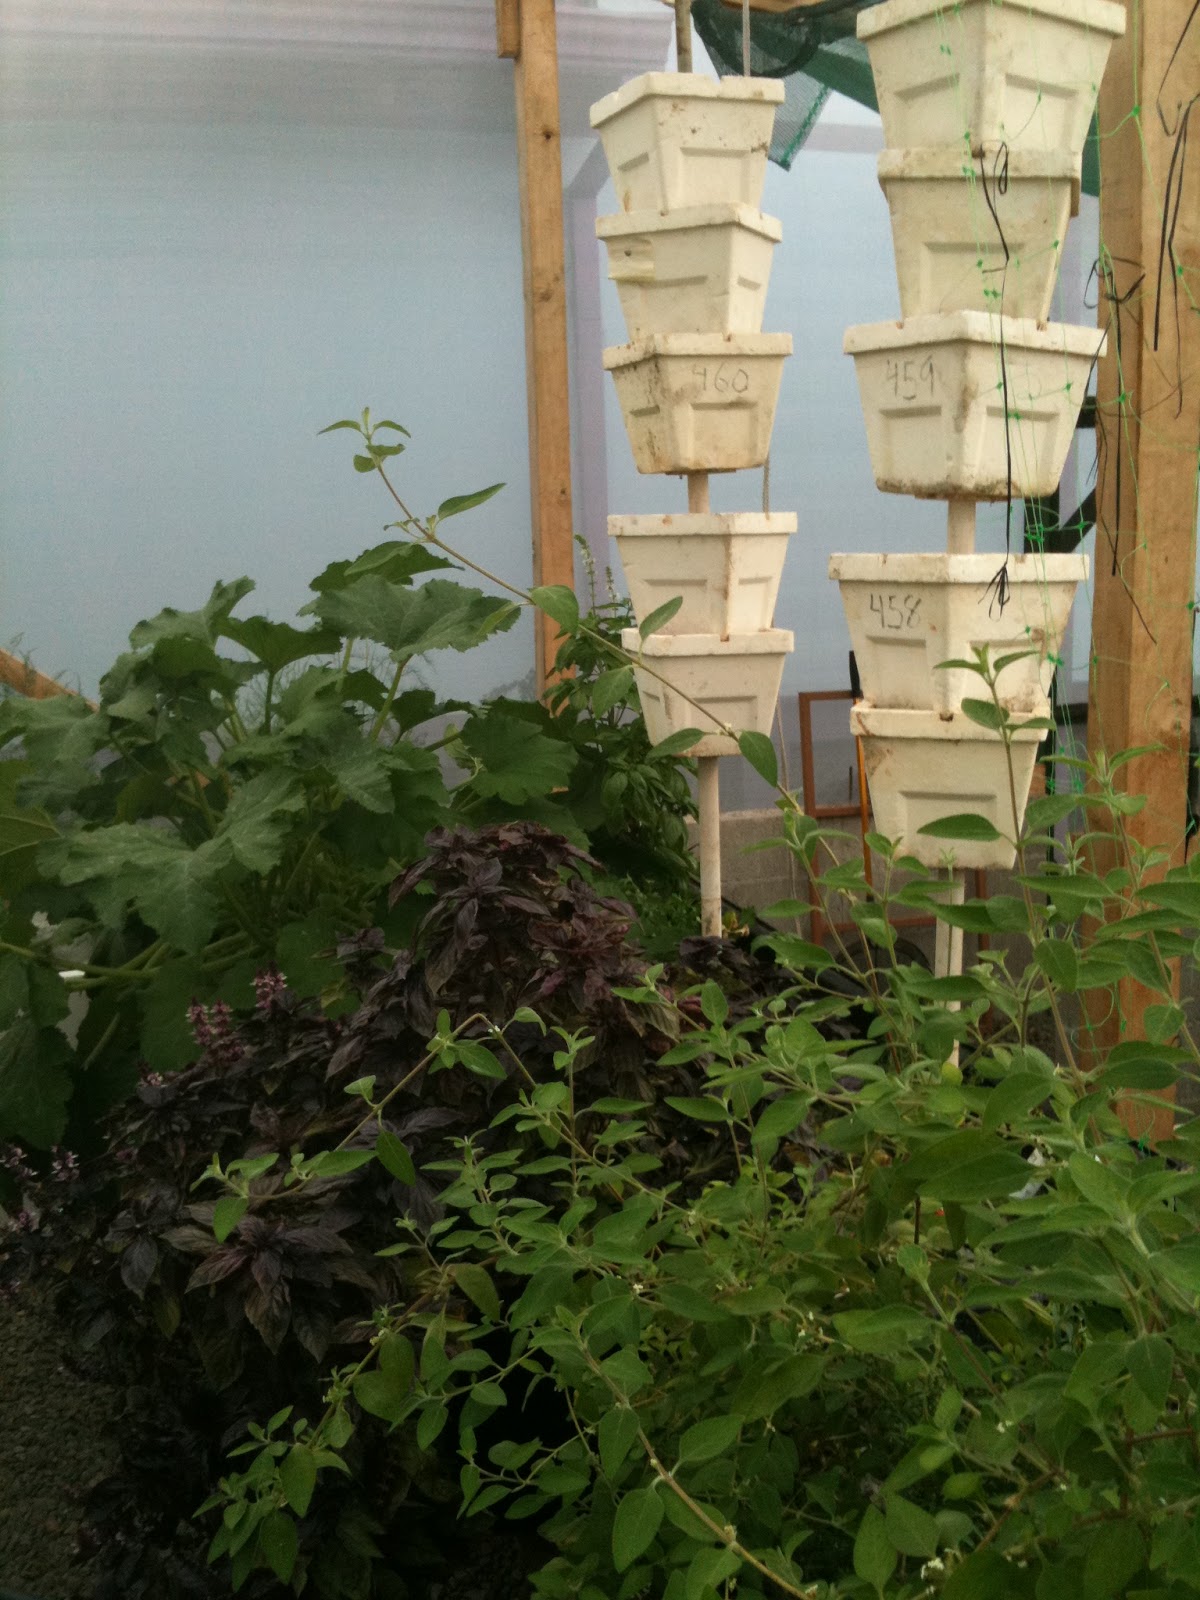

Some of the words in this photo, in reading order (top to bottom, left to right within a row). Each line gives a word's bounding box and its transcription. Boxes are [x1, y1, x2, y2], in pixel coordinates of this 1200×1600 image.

[691, 361, 749, 394] 460
[886, 354, 935, 401] 459
[869, 593, 922, 629] 458
